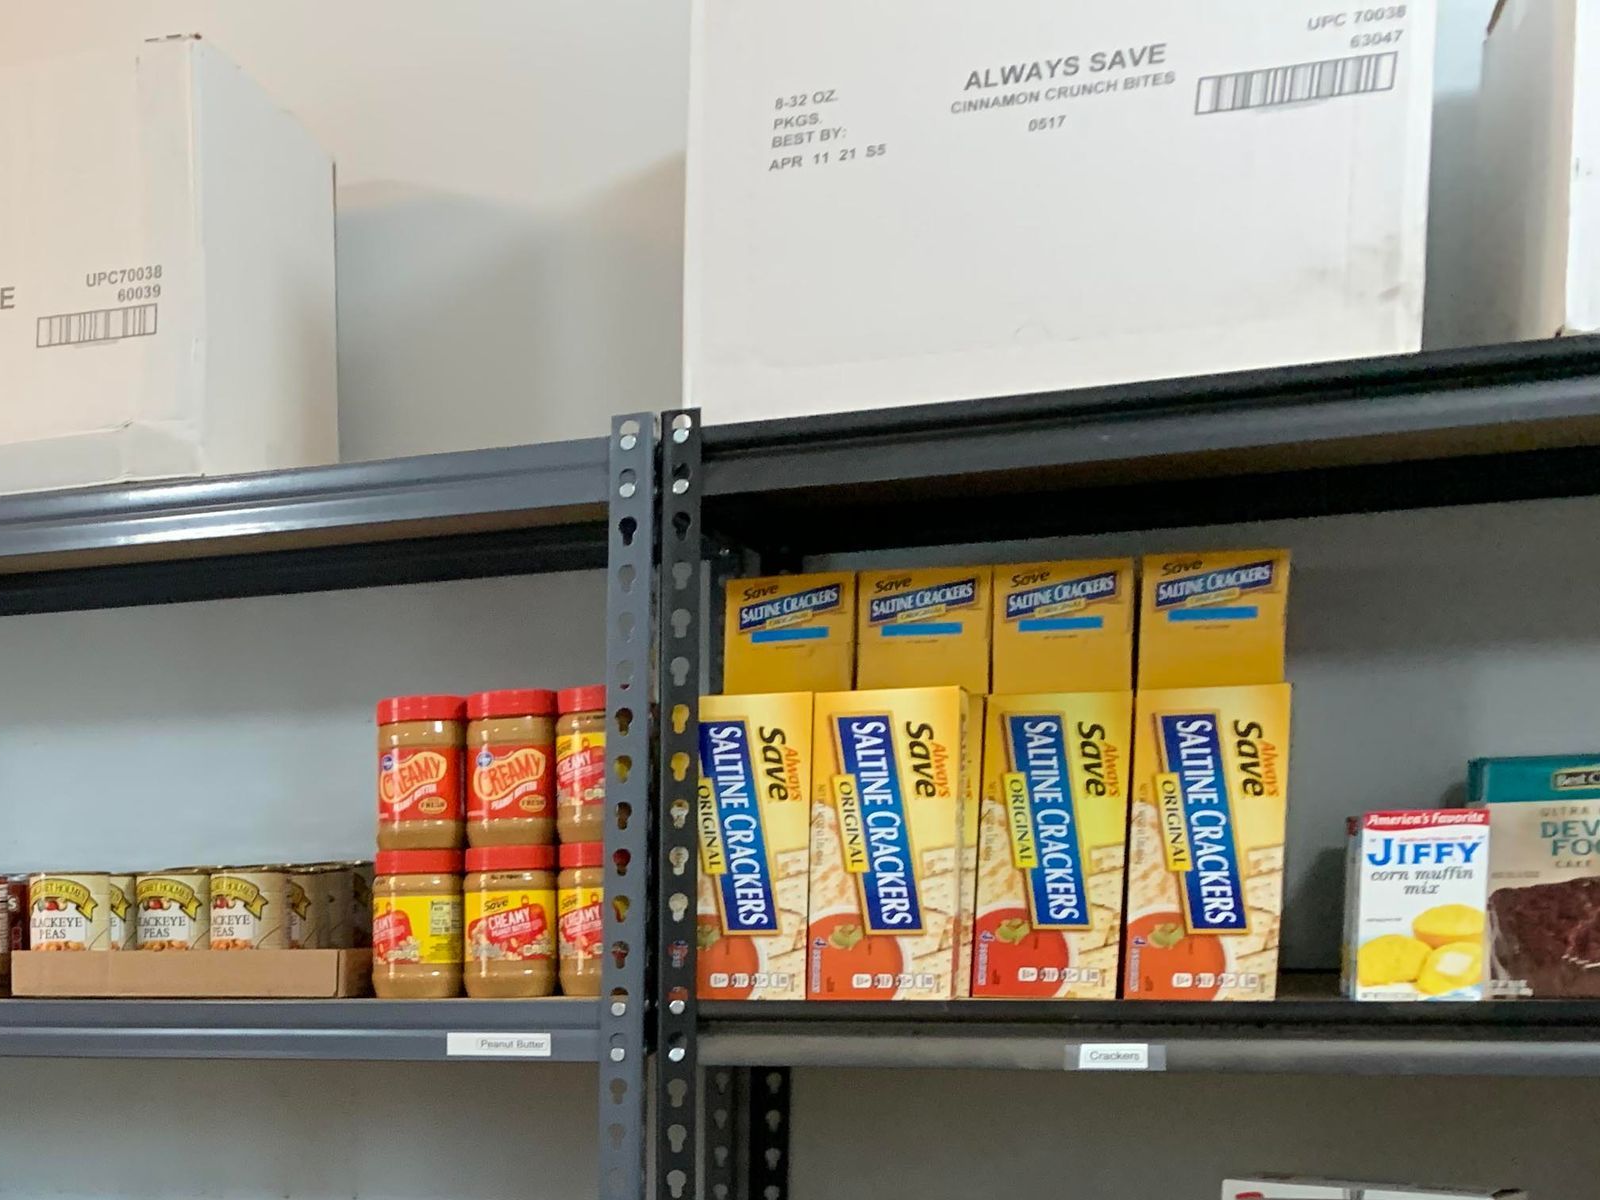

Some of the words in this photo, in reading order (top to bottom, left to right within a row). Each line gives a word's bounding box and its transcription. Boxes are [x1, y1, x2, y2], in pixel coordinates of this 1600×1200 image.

[1307, 11, 1347, 31] UPC
[1349, 30, 1404, 50] 63047
[964, 55, 1080, 92] ALWAYS
[1090, 44, 1167, 73] SAVE
[774, 94, 807, 110] 8-32
[950, 91, 1040, 115] CINNAMON
[1044, 80, 1118, 104] CRUNCH
[1123, 71, 1176, 93] BITES
[773, 113, 822, 130] PKGS.
[1028, 114, 1066, 133] 0517
[771, 131, 815, 149] BEST
[768, 156, 804, 172] APR
[813, 151, 830, 166] 11
[838, 148, 857, 163] 21
[86, 265, 163, 288] UPC70038
[117, 285, 161, 303] 60039
[875, 577, 912, 593] Save
[1011, 571, 1049, 587] Save
[1158, 580, 1205, 601] SALTINE
[1206, 565, 1270, 591] CRACKERS
[1162, 560, 1203, 576] Save
[742, 604, 781, 624] SALTINE
[783, 589, 838, 614] CRACKERS
[744, 585, 778, 600] Save
[872, 597, 914, 617] SALTINE
[916, 583, 973, 608] CRACKERS
[1008, 590, 1053, 611] SALTINE
[1054, 576, 1114, 602] CRACKERS
[479, 755, 543, 795] CREAMY
[709, 727, 749, 809] SALTINE
[759, 726, 788, 800] Save
[784, 748, 802, 800] Always
[851, 721, 893, 805] SALTINE
[905, 721, 936, 798] Save
[931, 743, 950, 797] Always
[1023, 721, 1062, 804] SALTINE
[1077, 721, 1106, 796] Save
[1103, 742, 1120, 796] Always
[1176, 720, 1217, 804] SALTINE
[1233, 719, 1264, 796] Save
[1260, 741, 1279, 797] Always
[384, 757, 442, 797] CREAMY
[698, 785, 722, 869] ORIGINAL
[838, 781, 863, 866] ORIGINAL
[1008, 779, 1033, 862] ORIGINAL
[1162, 780, 1186, 864] ORIGINAL
[1367, 812, 1429, 826] America's
[1432, 812, 1484, 825] Favorite
[867, 812, 912, 925] CRACKERS
[1036, 809, 1079, 920] CRACKERS
[1190, 810, 1237, 923] CRACKERS
[1367, 838, 1483, 866] JIFFY
[724, 815, 768, 926] CRACKERS
[1371, 869, 1409, 881] corn
[1415, 866, 1473, 881] muffin
[1404, 882, 1441, 895] mix
[39, 928, 66, 939] PEAS
[144, 927, 170, 938] PEAS
[488, 909, 529, 929] CREAMY
[481, 1039, 514, 1048] Peanut
[516, 1039, 544, 1048] Butter
[1090, 1049, 1141, 1062] Crackers
